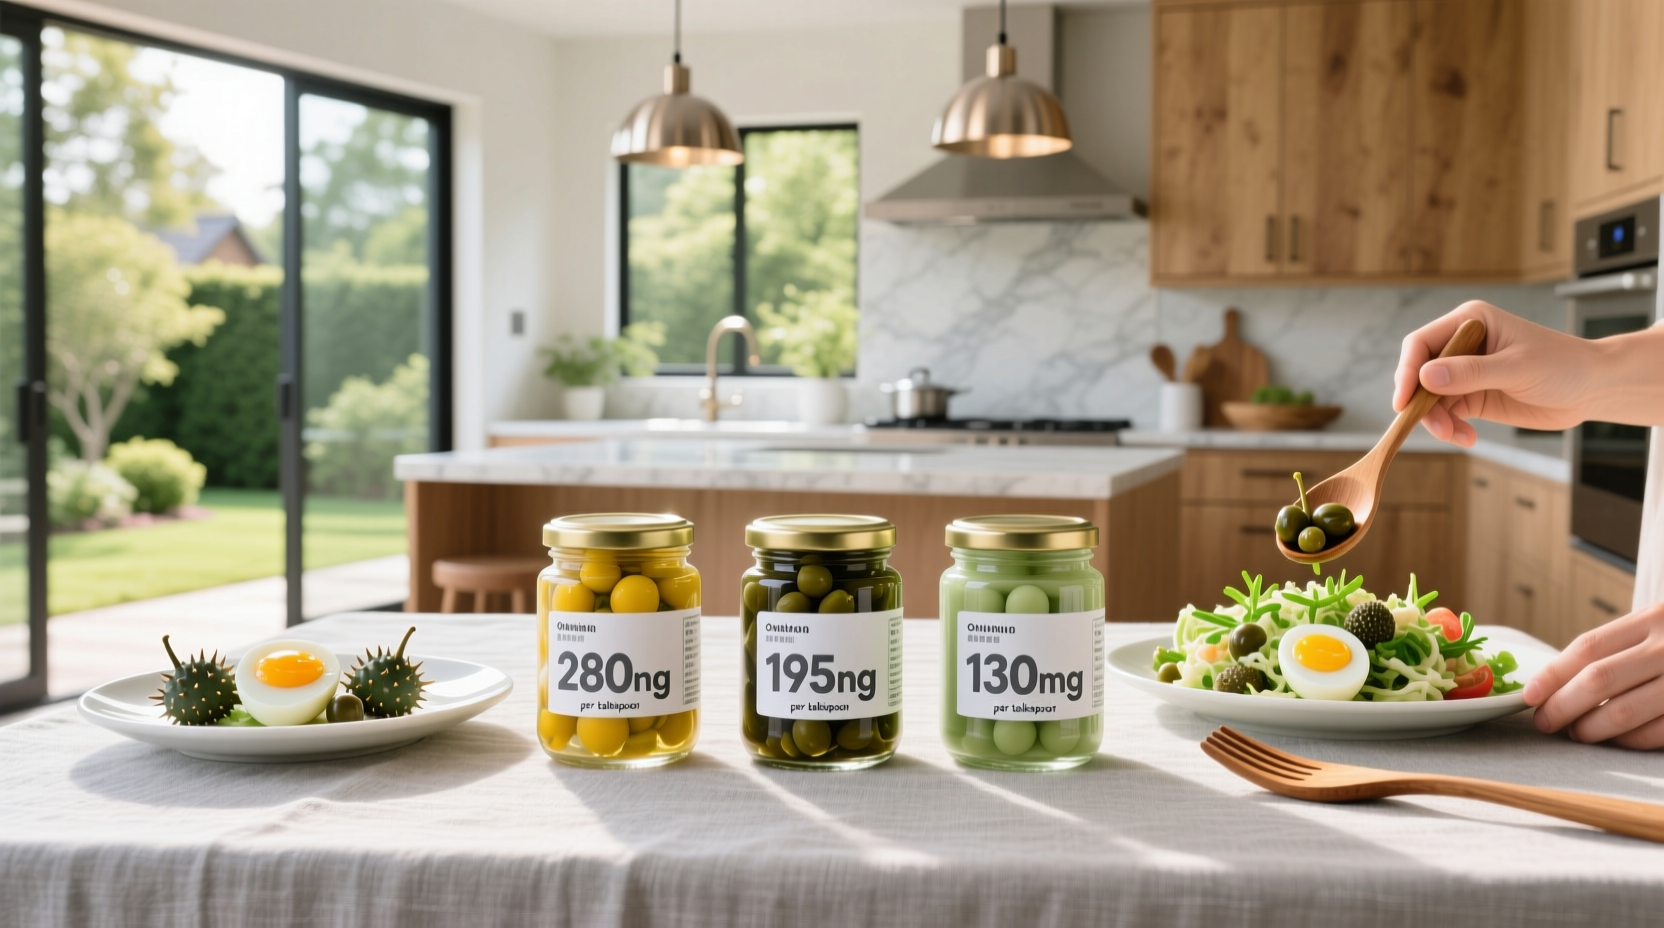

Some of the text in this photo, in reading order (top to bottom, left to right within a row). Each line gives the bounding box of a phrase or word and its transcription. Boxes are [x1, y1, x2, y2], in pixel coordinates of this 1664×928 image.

[558, 651, 670, 700] 280ng
[766, 652, 876, 701] 195ng
[966, 652, 1083, 702] 130mg
[581, 702, 595, 713] per
